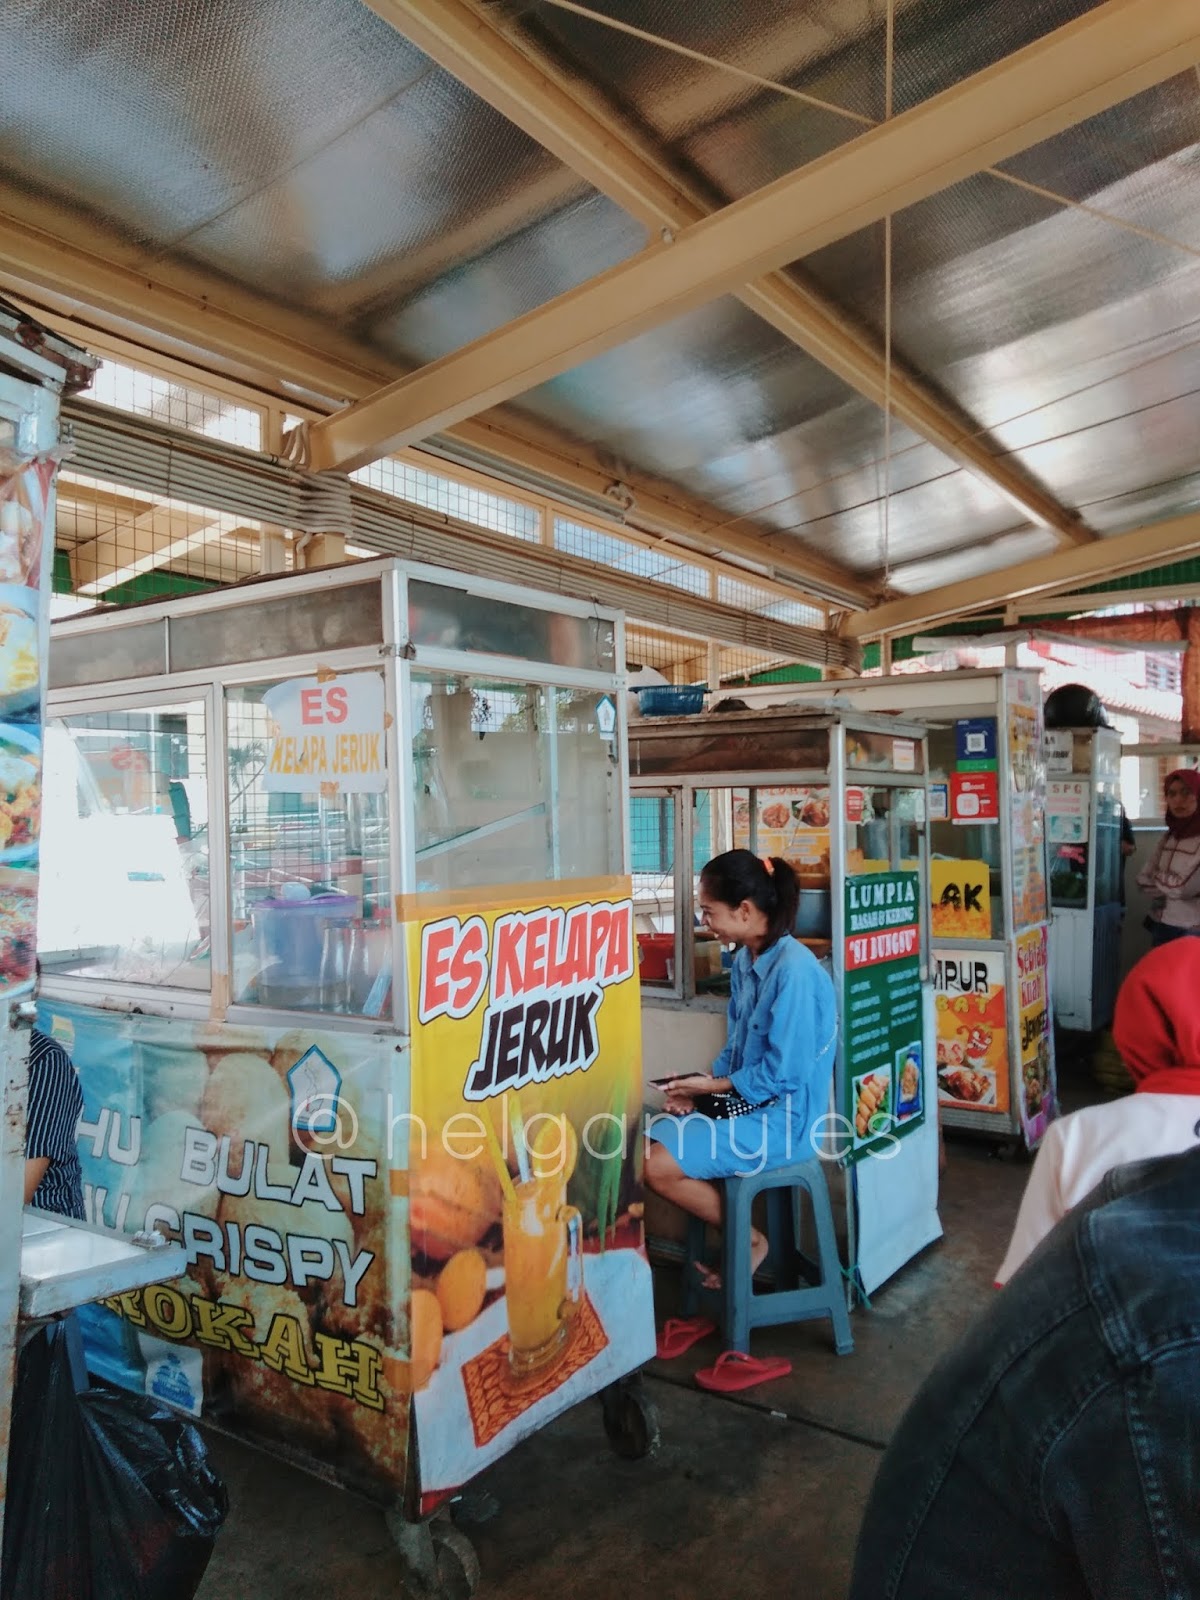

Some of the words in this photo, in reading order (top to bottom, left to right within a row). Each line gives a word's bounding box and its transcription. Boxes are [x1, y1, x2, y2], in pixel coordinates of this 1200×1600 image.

[300, 687, 349, 725] ES
[269, 735, 328, 775] KELAPA
[333, 733, 380, 774] JERUK
[849, 880, 915, 909] LUMPIA
[932, 883, 983, 912] AK
[421, 918, 487, 1021] ES
[492, 902, 633, 1003] KELAPA
[466, 988, 602, 1096] JERUK
[180, 1126, 376, 1216] BULAT
[143, 1202, 375, 1307] CRISPY
